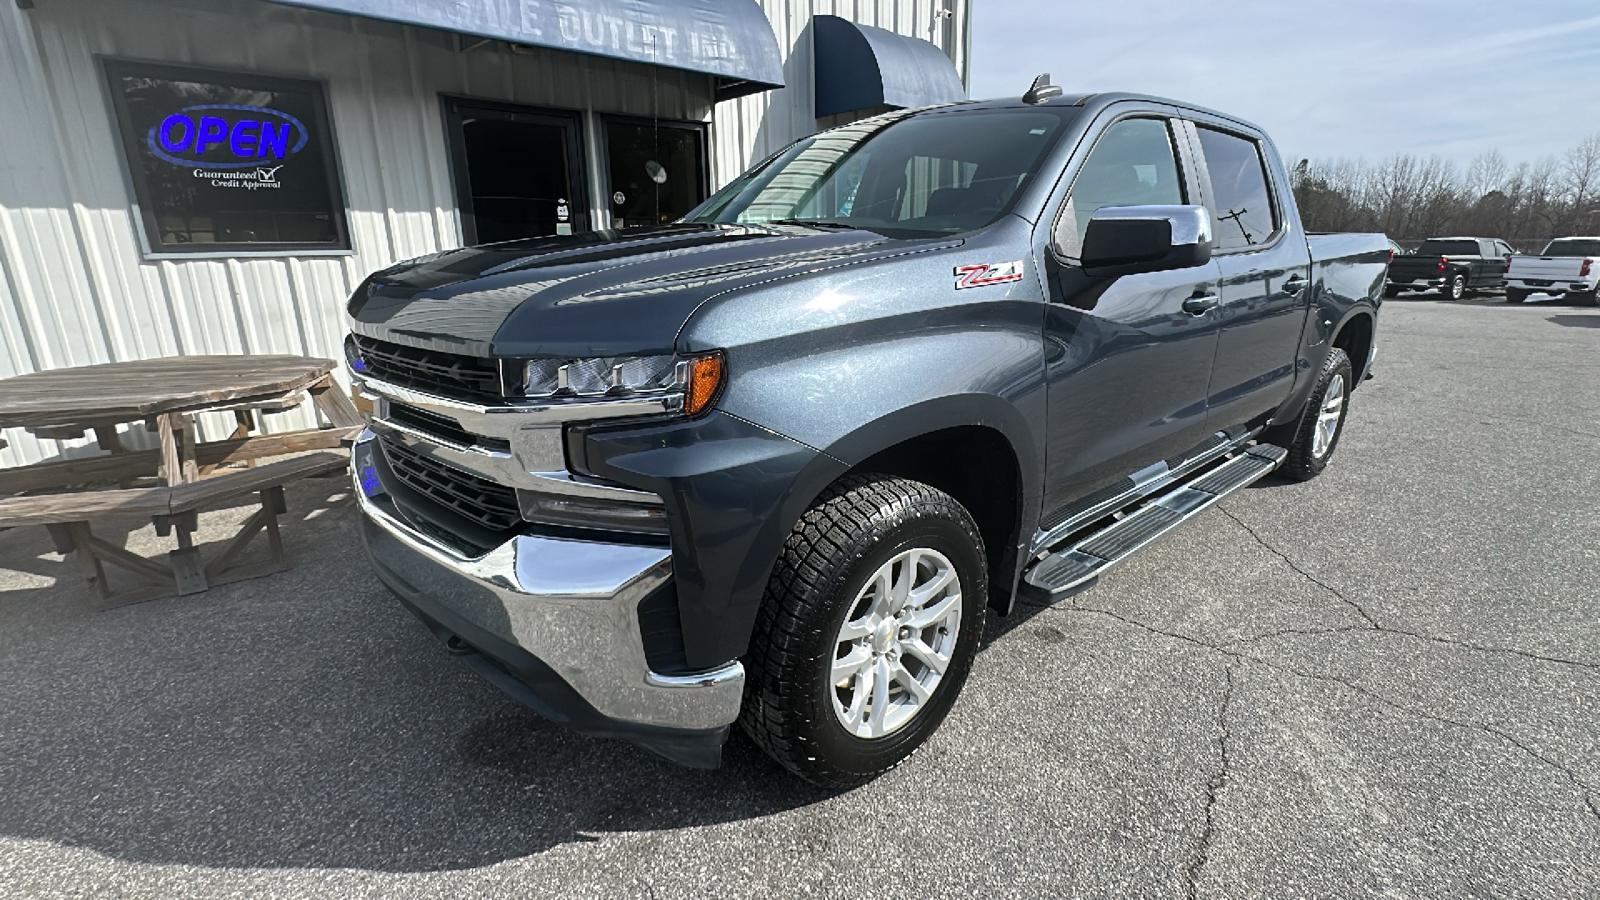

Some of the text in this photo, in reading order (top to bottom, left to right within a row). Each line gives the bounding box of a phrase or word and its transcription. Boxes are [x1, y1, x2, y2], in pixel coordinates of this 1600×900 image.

[556, 5, 677, 58] OUTLET
[160, 114, 290, 159] OPEN
[193, 168, 258, 180] Guaranteed
[211, 179, 281, 190] Credit Approval
